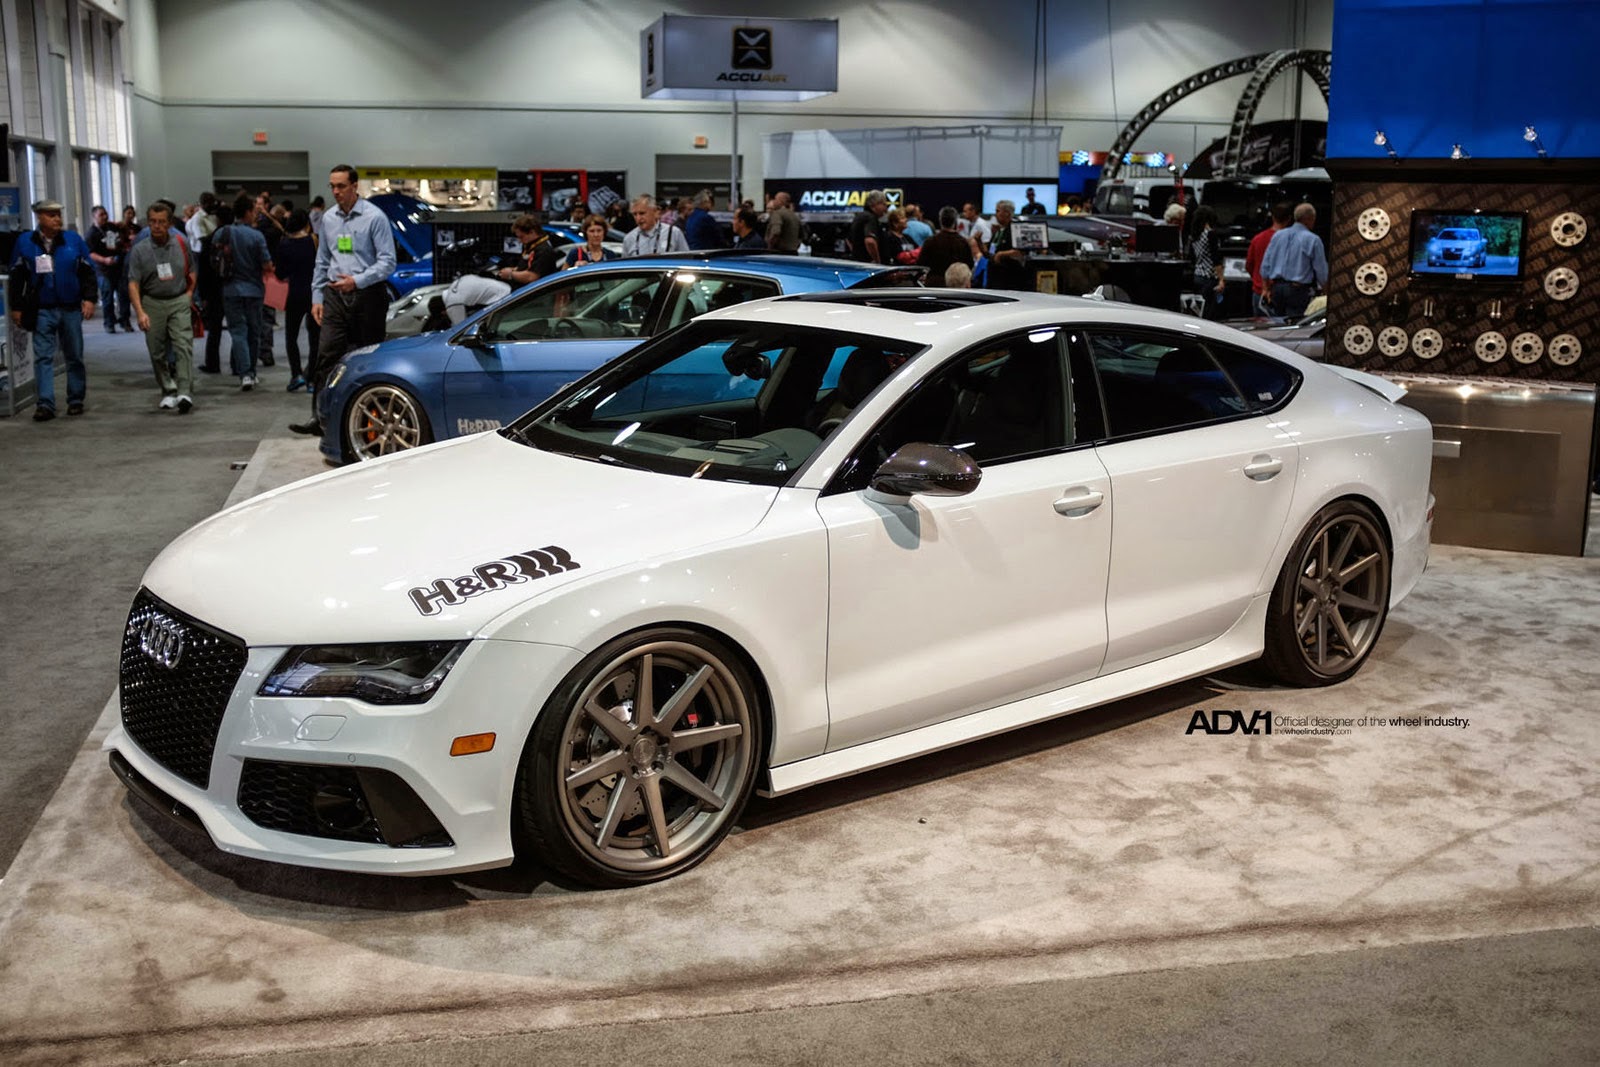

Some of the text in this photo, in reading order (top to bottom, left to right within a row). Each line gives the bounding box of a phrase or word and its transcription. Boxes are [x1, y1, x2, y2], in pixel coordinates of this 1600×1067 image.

[716, 72, 787, 83] ACCUAIR
[799, 190, 869, 206] ACCUAI
[408, 561, 528, 616] H&R
